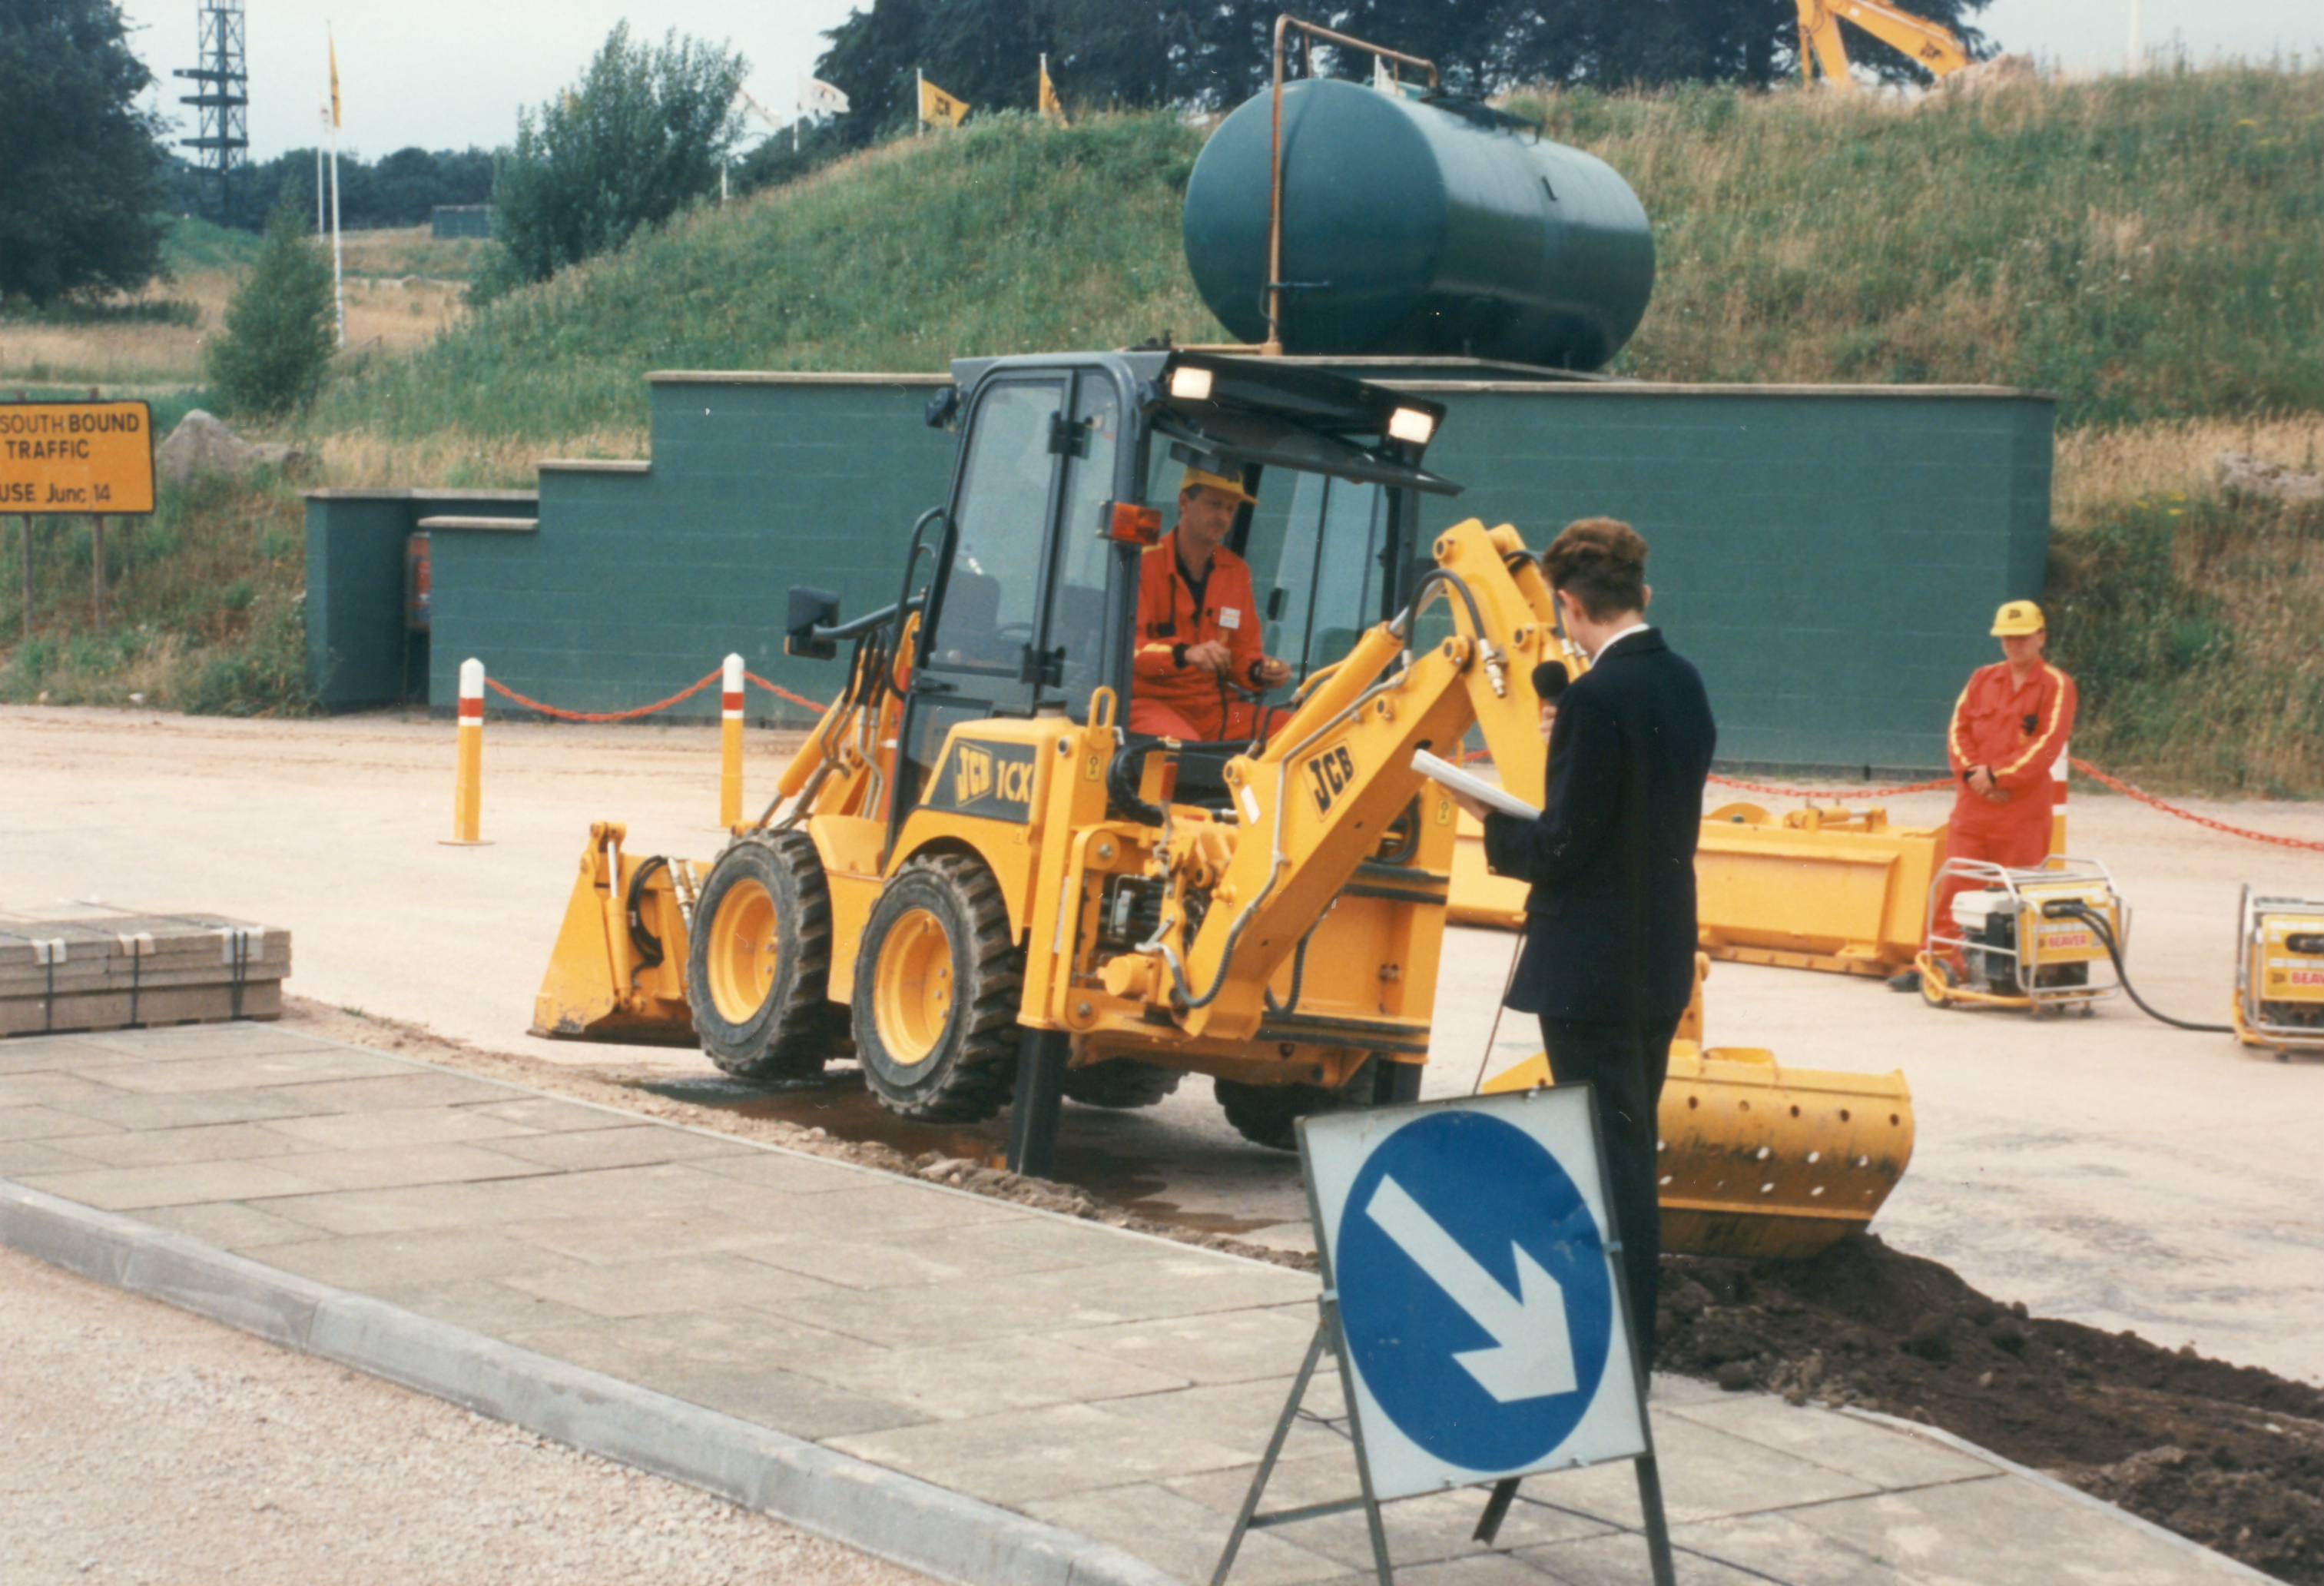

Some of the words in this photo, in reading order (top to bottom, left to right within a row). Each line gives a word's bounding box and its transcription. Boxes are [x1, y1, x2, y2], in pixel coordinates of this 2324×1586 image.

[5, 439, 90, 458] TRAFFIC
[0, 483, 35, 502] USE
[93, 483, 111, 503] 14
[956, 745, 991, 802] JCB
[1308, 745, 1354, 815] JCB
